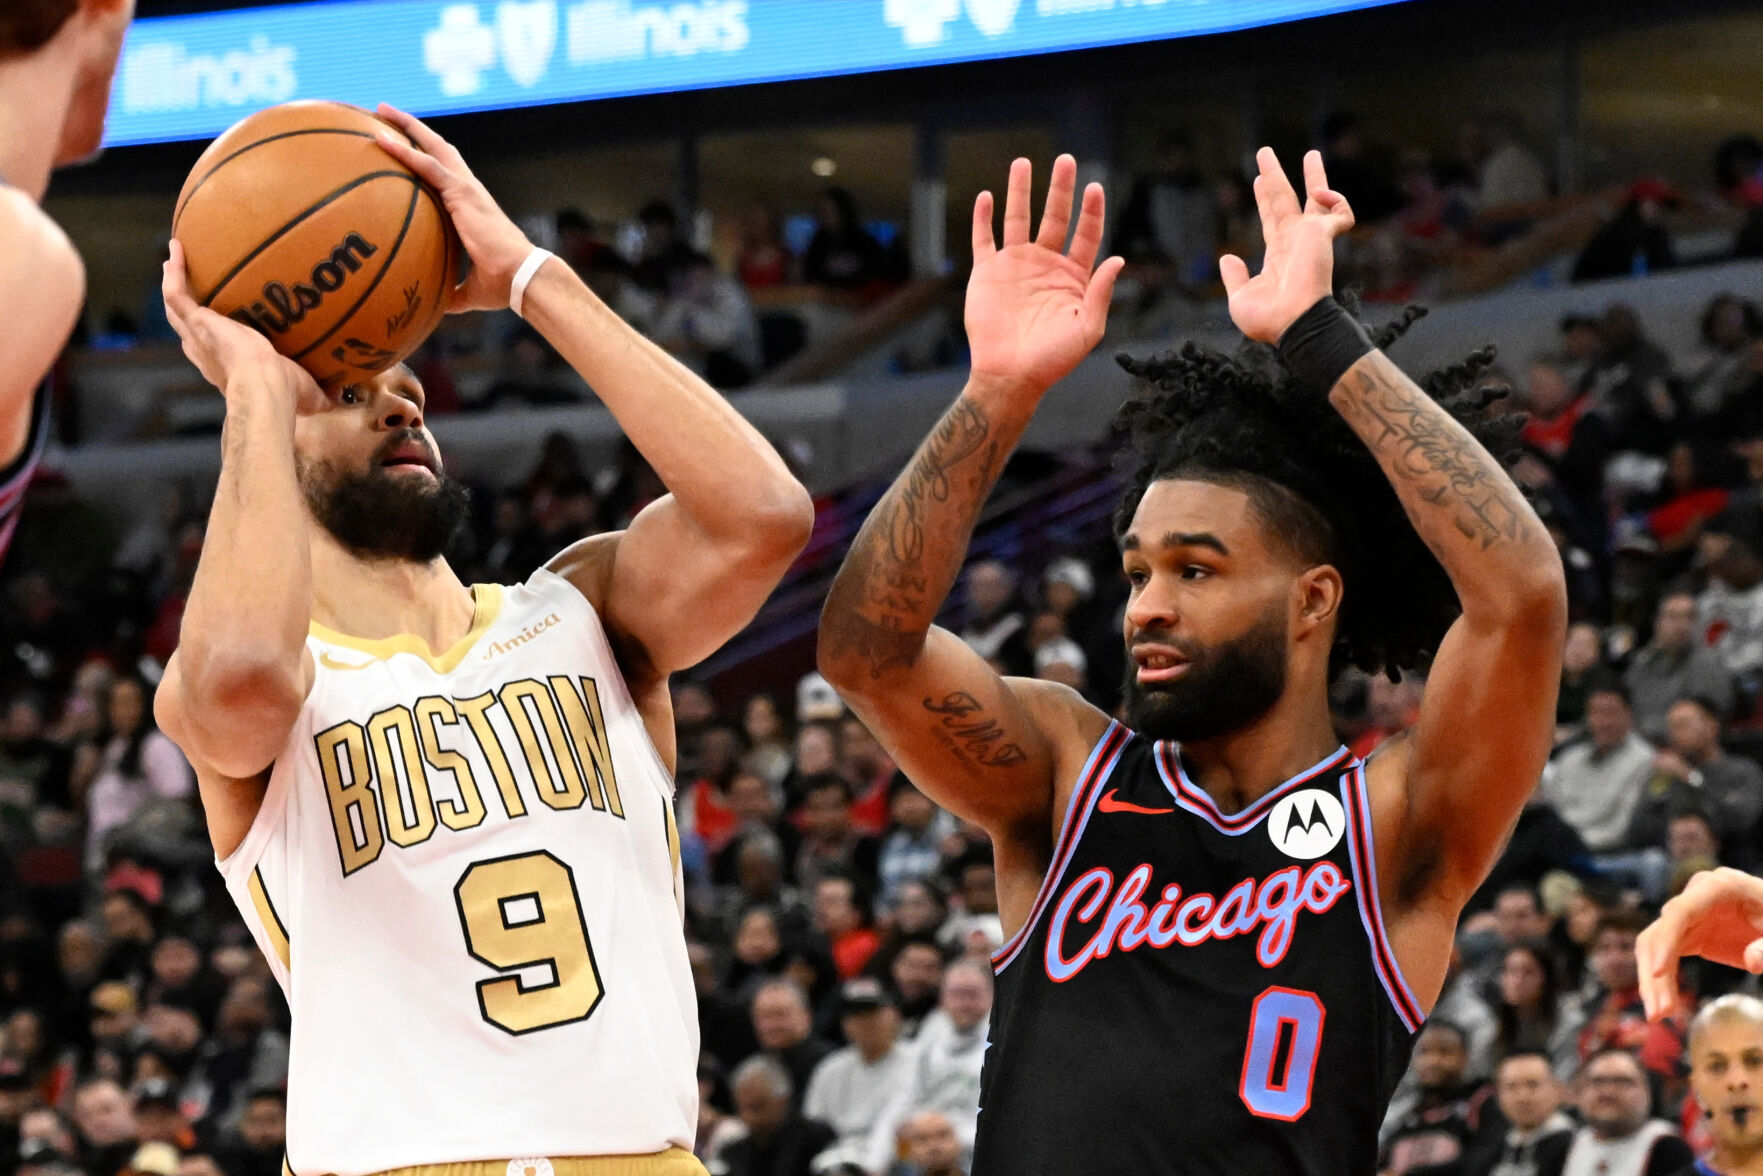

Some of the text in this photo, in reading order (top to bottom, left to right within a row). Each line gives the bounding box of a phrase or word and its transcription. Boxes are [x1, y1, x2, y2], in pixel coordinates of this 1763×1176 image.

[482, 613, 563, 660] Amica
[313, 674, 626, 878] BOSTON
[453, 848, 605, 1037] 9
[1044, 860, 1351, 983] Chicago
[1239, 984, 1327, 1123] 0
